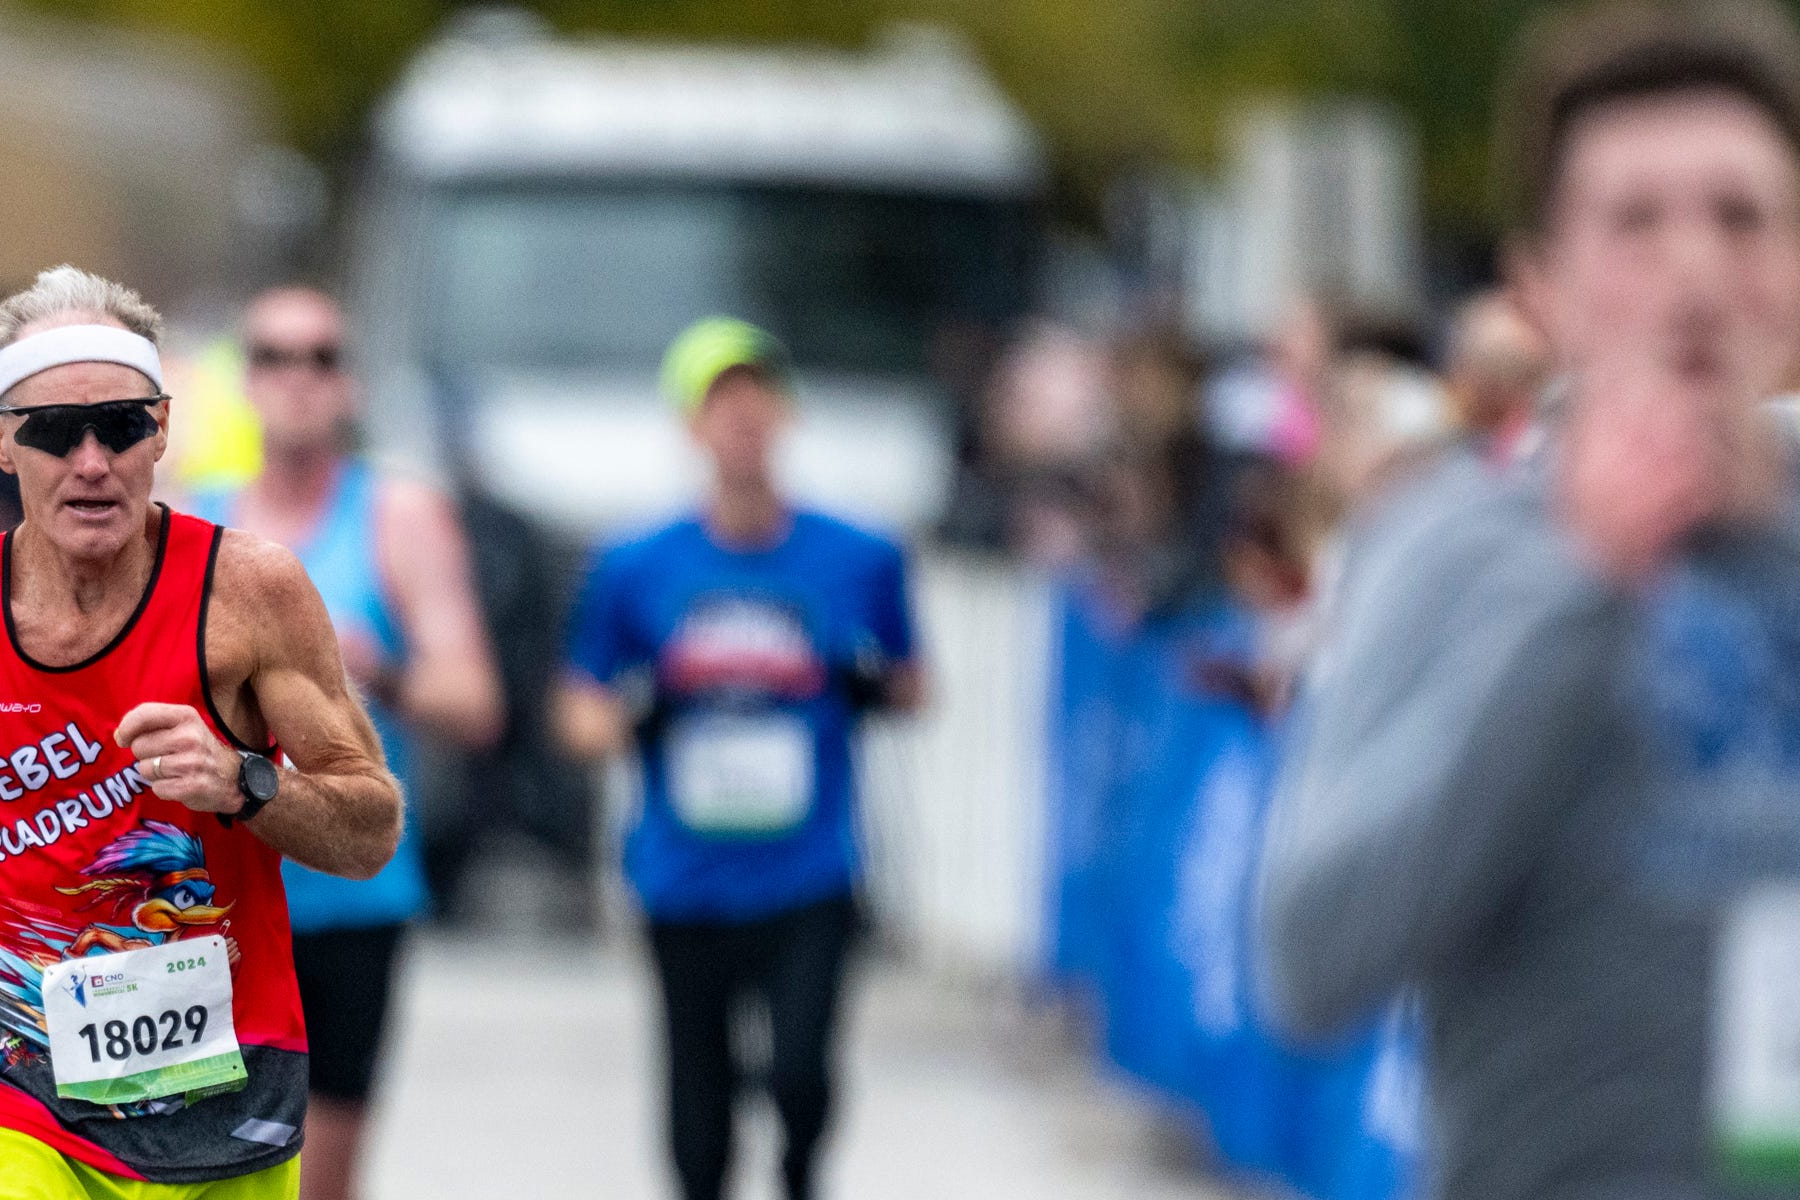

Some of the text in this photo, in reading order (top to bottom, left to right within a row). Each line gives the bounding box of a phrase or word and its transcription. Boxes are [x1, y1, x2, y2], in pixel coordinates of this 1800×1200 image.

[166, 956, 207, 974] 2024
[104, 973, 124, 983] CNO
[78, 1004, 209, 1063] 18029
